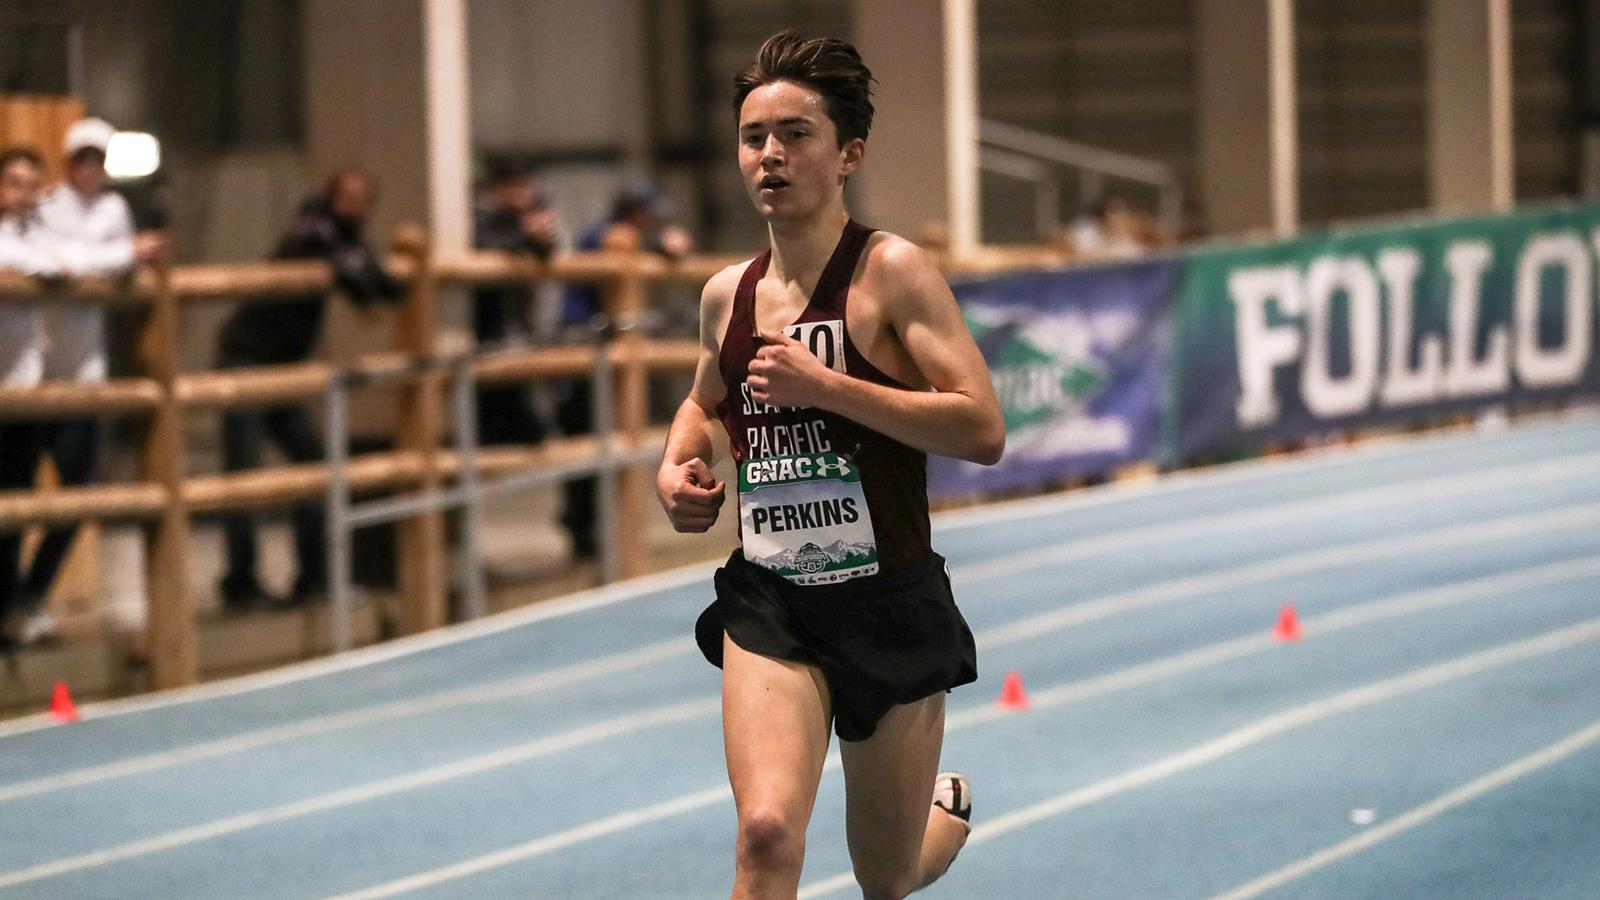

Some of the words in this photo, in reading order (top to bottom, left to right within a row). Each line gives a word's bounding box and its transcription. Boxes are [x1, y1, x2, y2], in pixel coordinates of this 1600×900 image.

[1229, 226, 1600, 430] FOLLO
[747, 419, 832, 460] PACIFIC
[746, 457, 813, 484] GNAC
[752, 497, 859, 535] PERKINS
